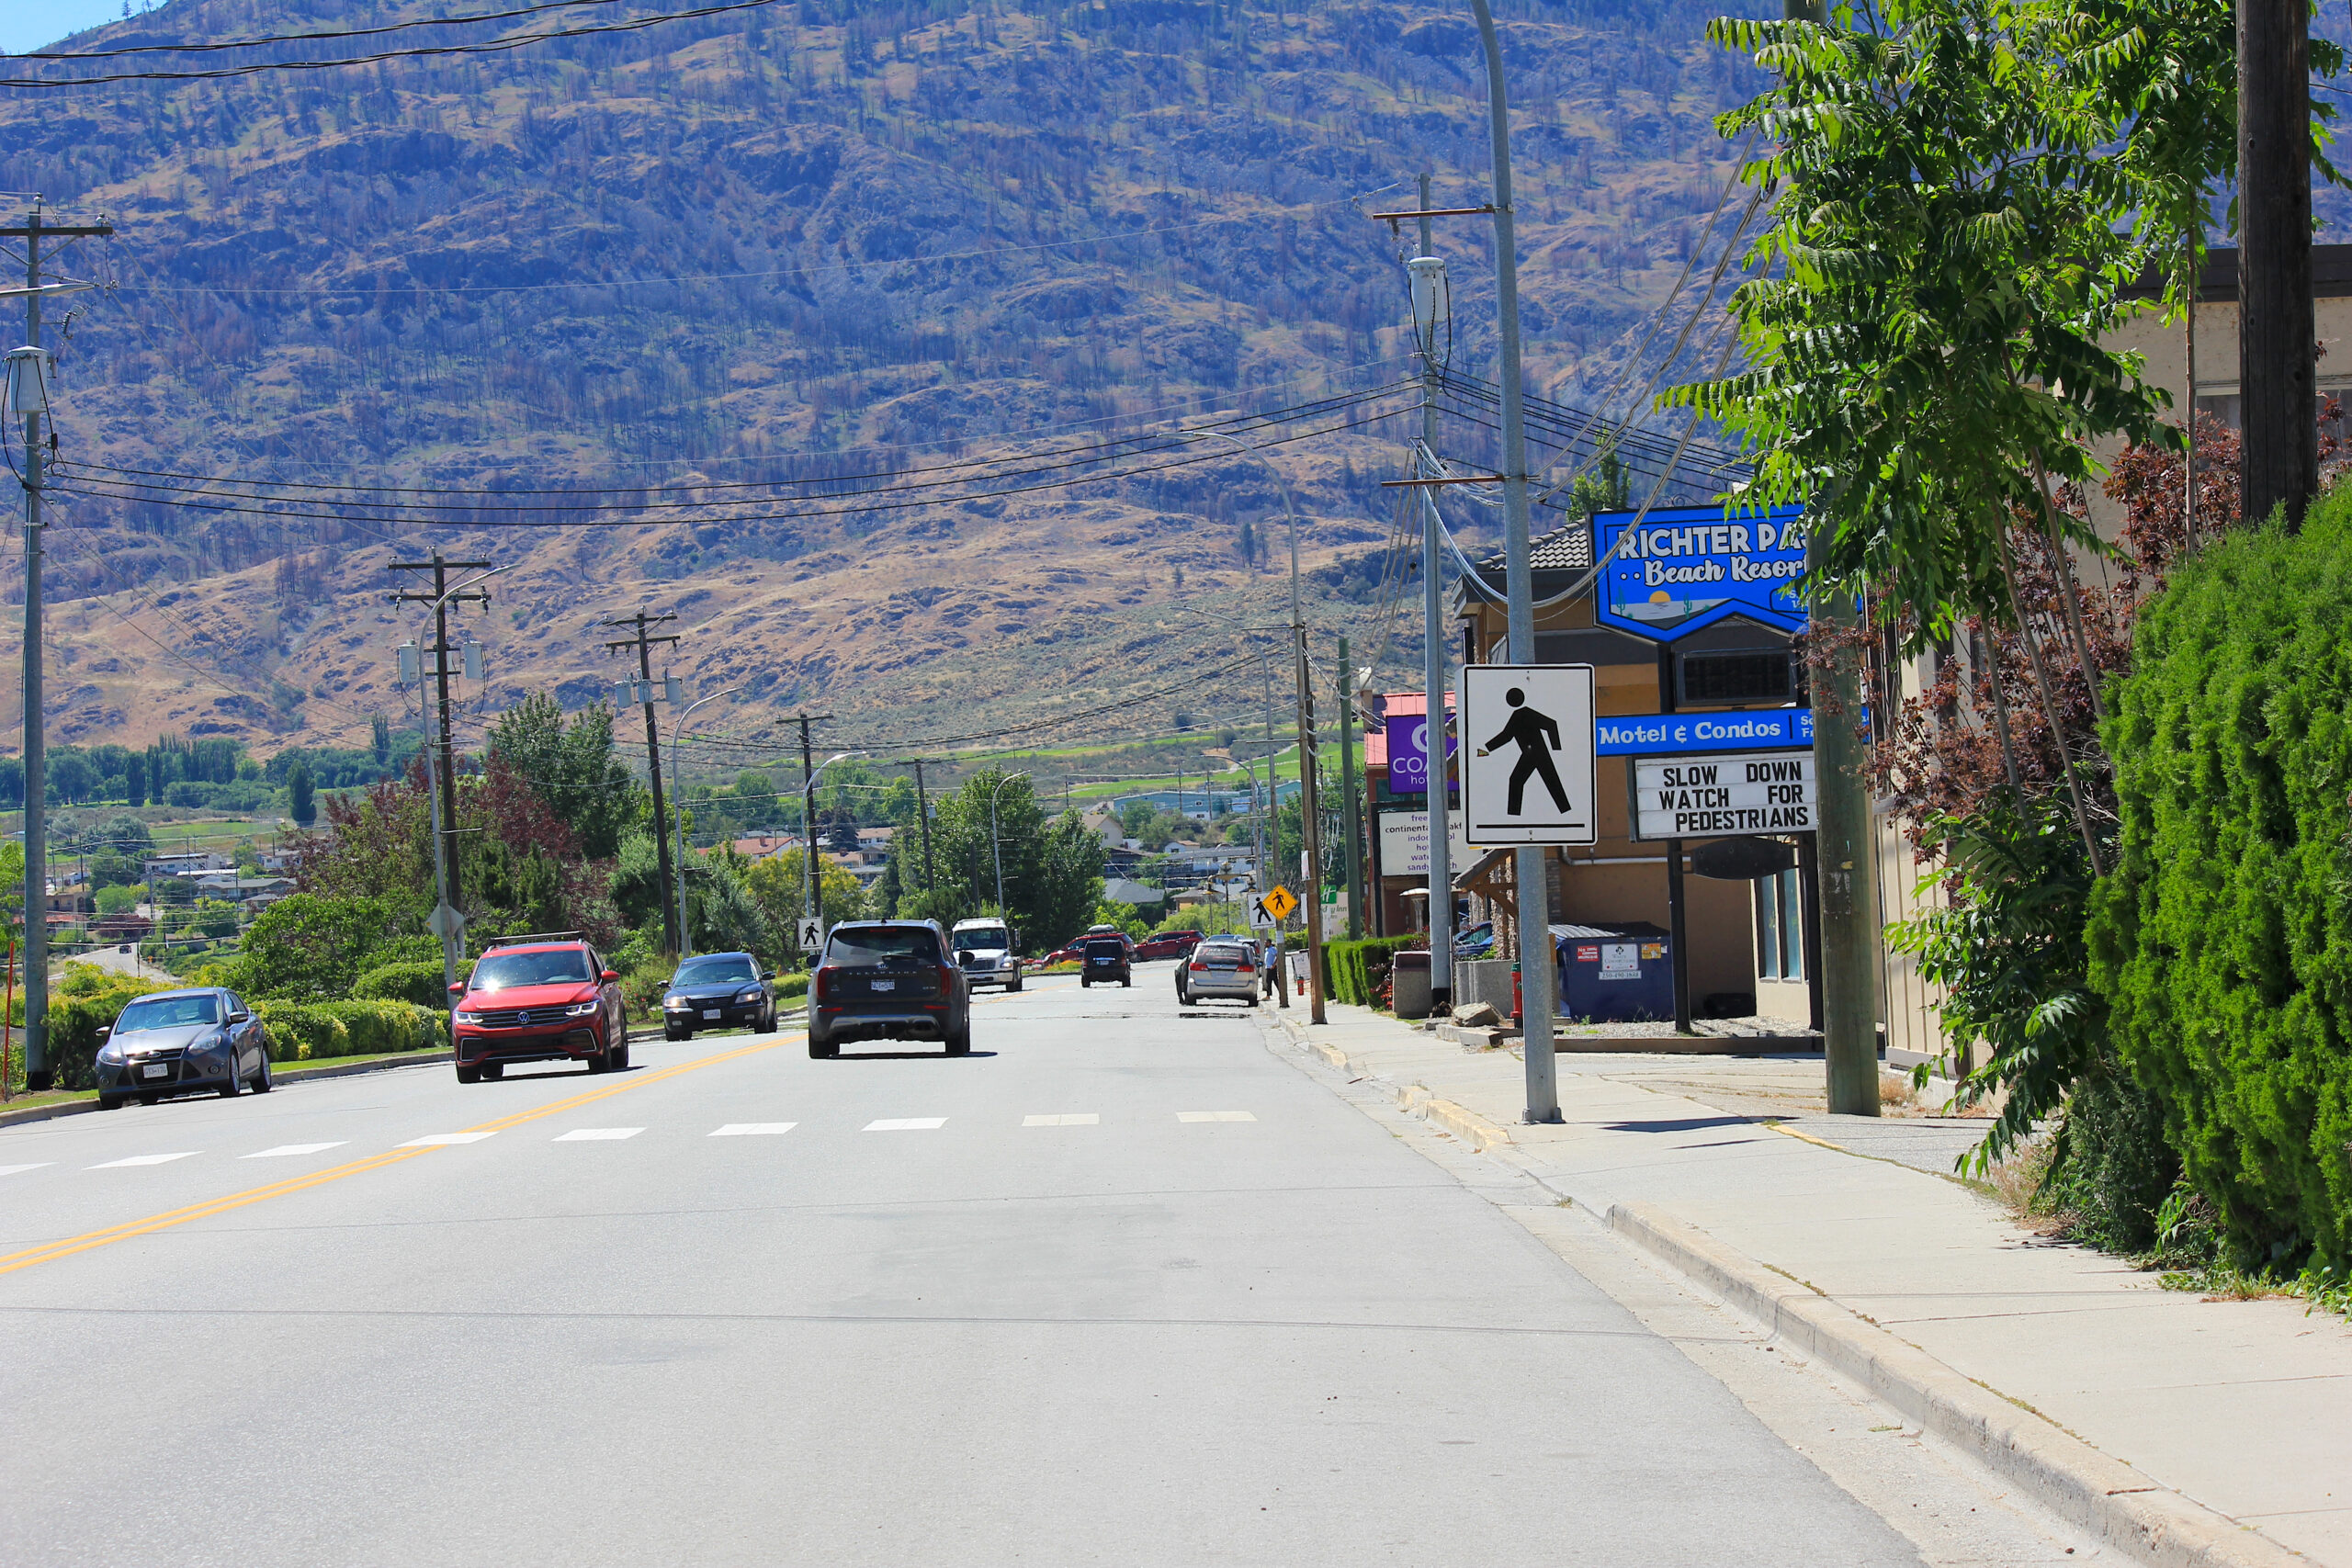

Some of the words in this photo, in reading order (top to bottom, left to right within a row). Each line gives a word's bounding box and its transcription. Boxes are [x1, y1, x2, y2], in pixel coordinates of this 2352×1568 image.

[1618, 525, 1752, 559] RICHTER
[1758, 522, 1807, 551] PA
[1644, 559, 1726, 587] Beach
[1599, 725, 1668, 745] Motel
[1694, 719, 1781, 740] Condos
[1663, 764, 1718, 787] SLOW
[1746, 761, 1803, 783] DOWN
[1659, 787, 1730, 810] WATCH
[1767, 784, 1804, 805] FOR
[1675, 806, 1809, 832] PEDESTRIANS
